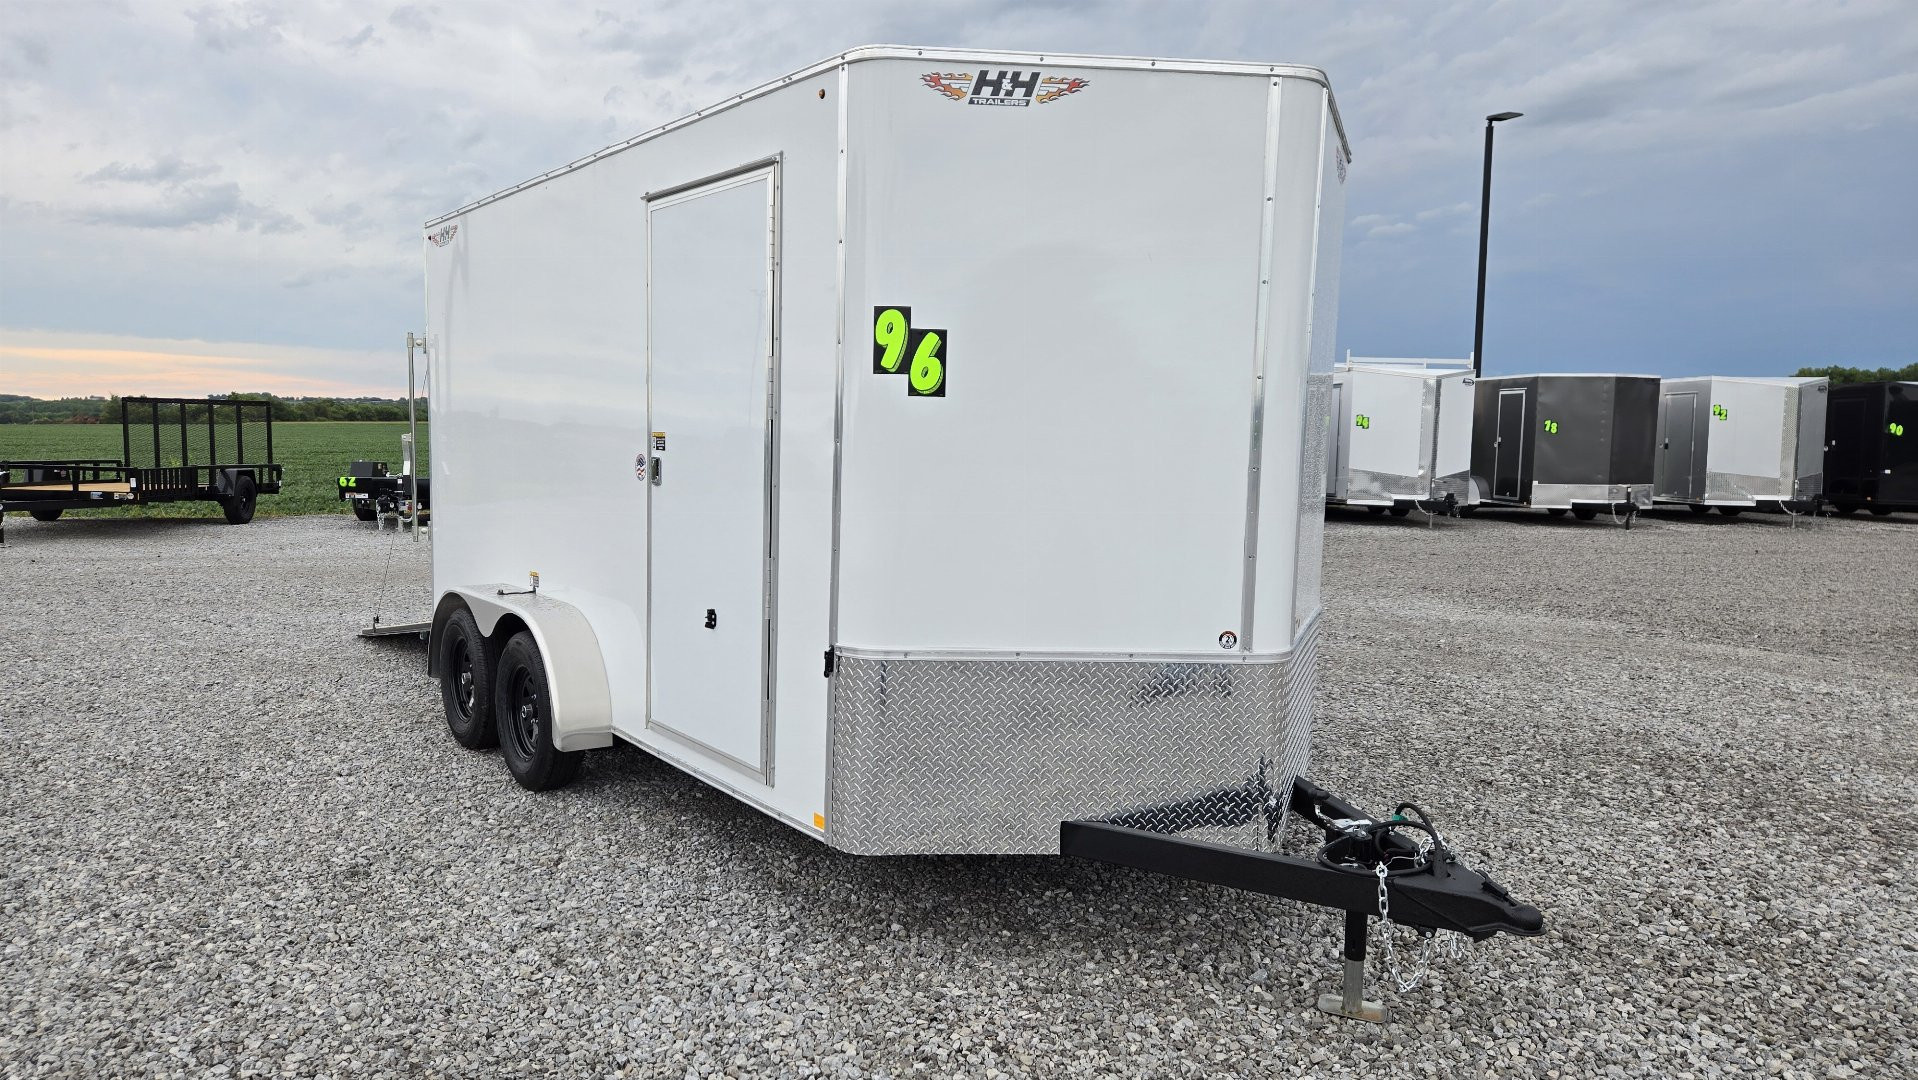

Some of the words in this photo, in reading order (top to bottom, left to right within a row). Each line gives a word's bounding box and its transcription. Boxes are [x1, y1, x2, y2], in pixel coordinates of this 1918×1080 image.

[971, 70, 1041, 97] H&H
[973, 98, 1027, 106] TRAILERS
[875, 308, 944, 394] 96
[1713, 405, 1727, 420] 92
[1890, 422, 1903, 436] 90
